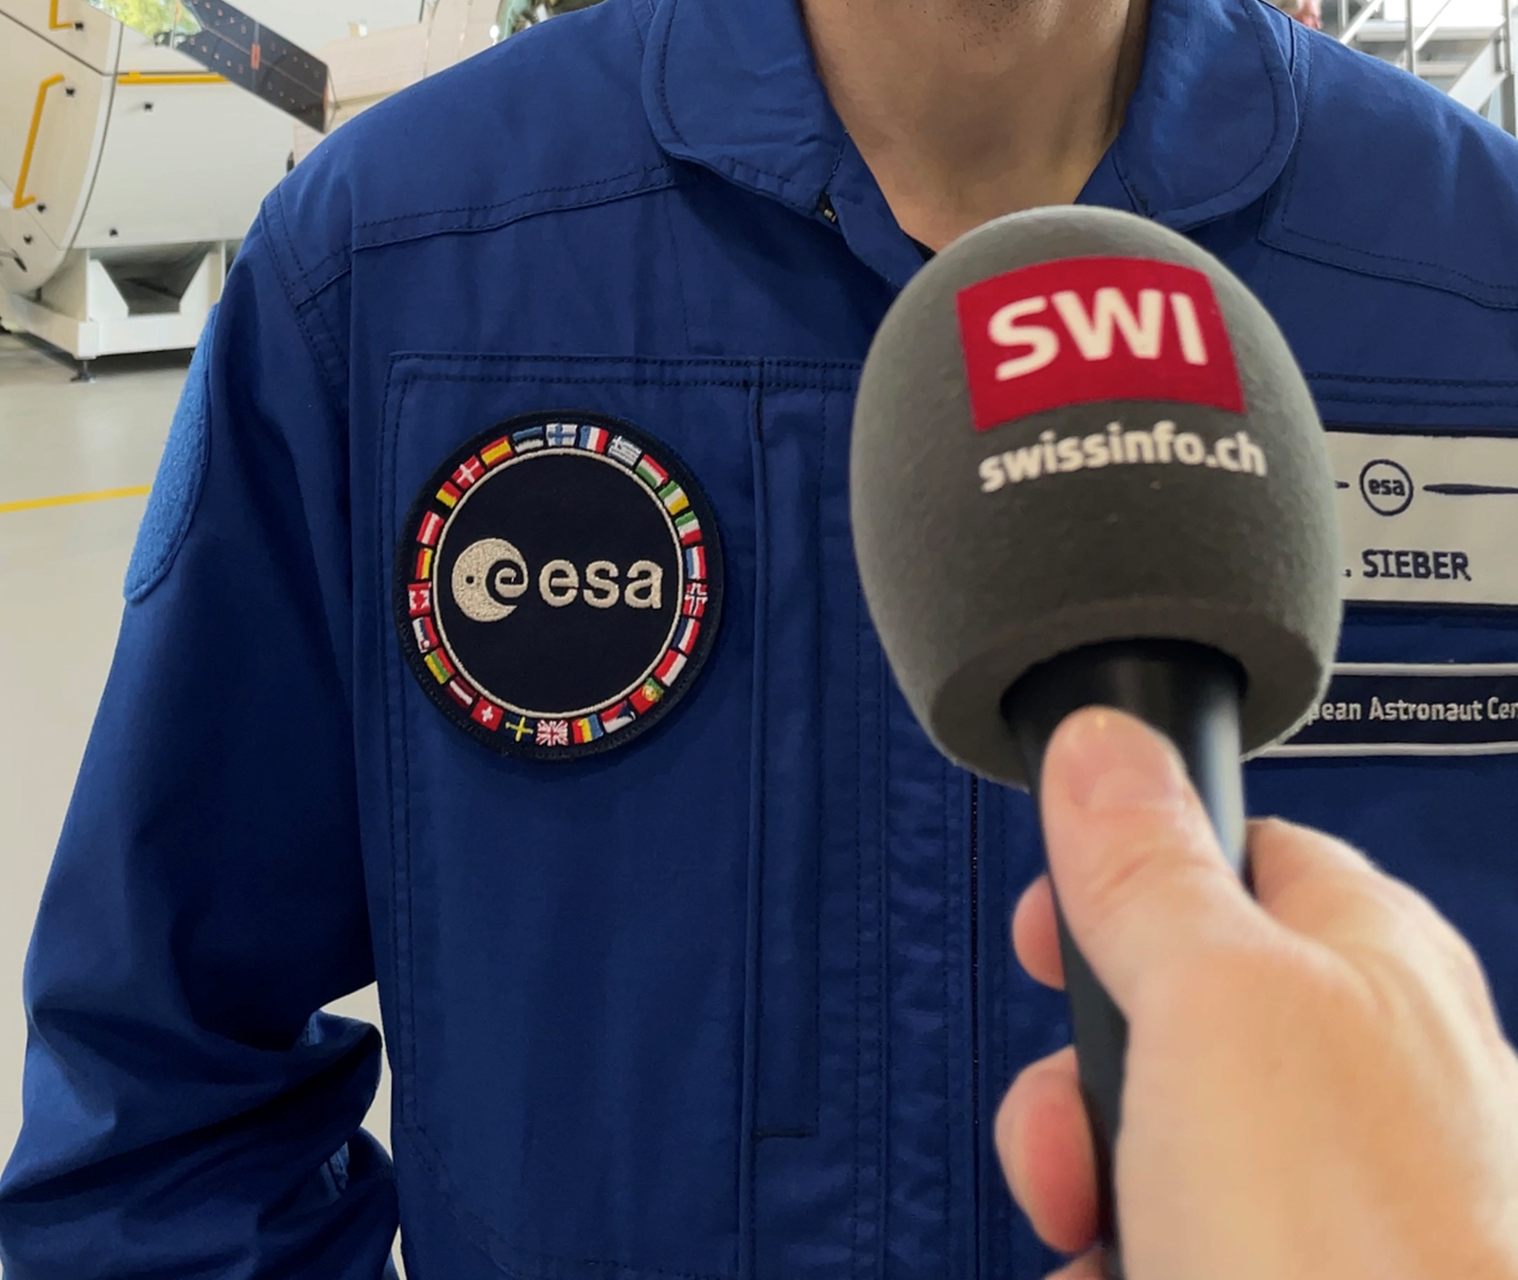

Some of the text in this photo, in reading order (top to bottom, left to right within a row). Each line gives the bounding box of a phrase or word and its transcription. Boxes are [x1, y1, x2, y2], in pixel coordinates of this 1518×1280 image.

[987, 286, 1208, 381] SWI
[978, 420, 1267, 493] swissinfo.ch
[1368, 477, 1406, 497] esa
[538, 559, 664, 610] esa
[1361, 549, 1473, 582] SIEBER
[1307, 696, 1518, 726] pean Astronaut Cen
